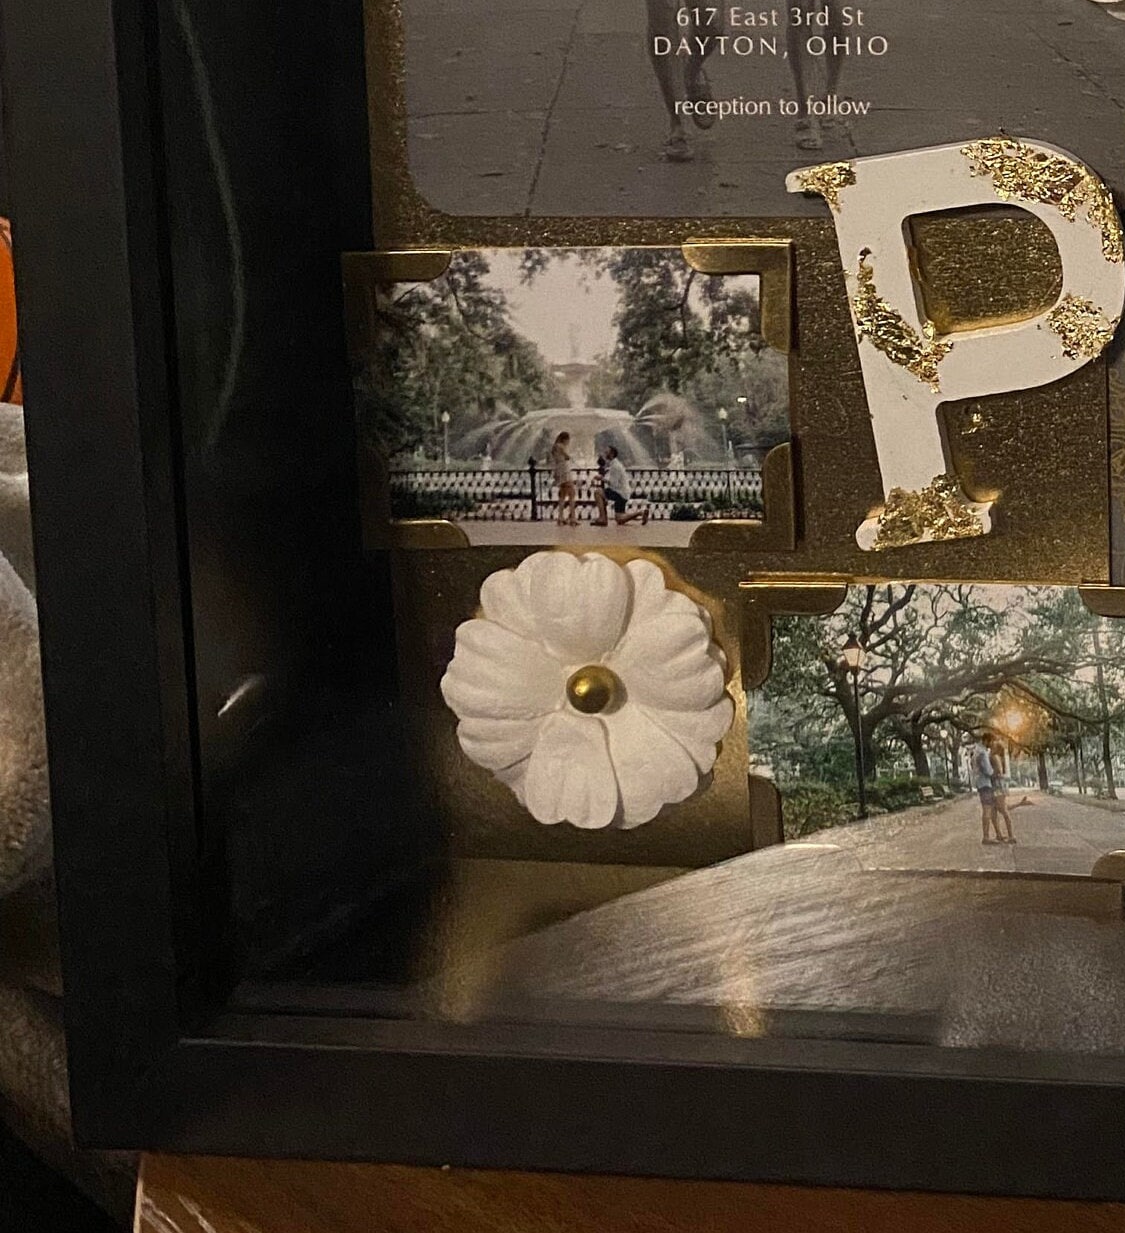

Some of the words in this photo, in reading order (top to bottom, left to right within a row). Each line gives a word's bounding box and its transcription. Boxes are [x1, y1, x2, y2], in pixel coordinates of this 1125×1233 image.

[676, 7, 717, 27] 617
[730, 7, 779, 27] East
[790, 6, 830, 27] 3rd
[841, 7, 865, 27] St
[653, 36, 789, 59] DAYTON,
[806, 36, 889, 56] OHIO
[674, 97, 771, 120] reception
[778, 99, 799, 115] to
[806, 96, 871, 115] follow
